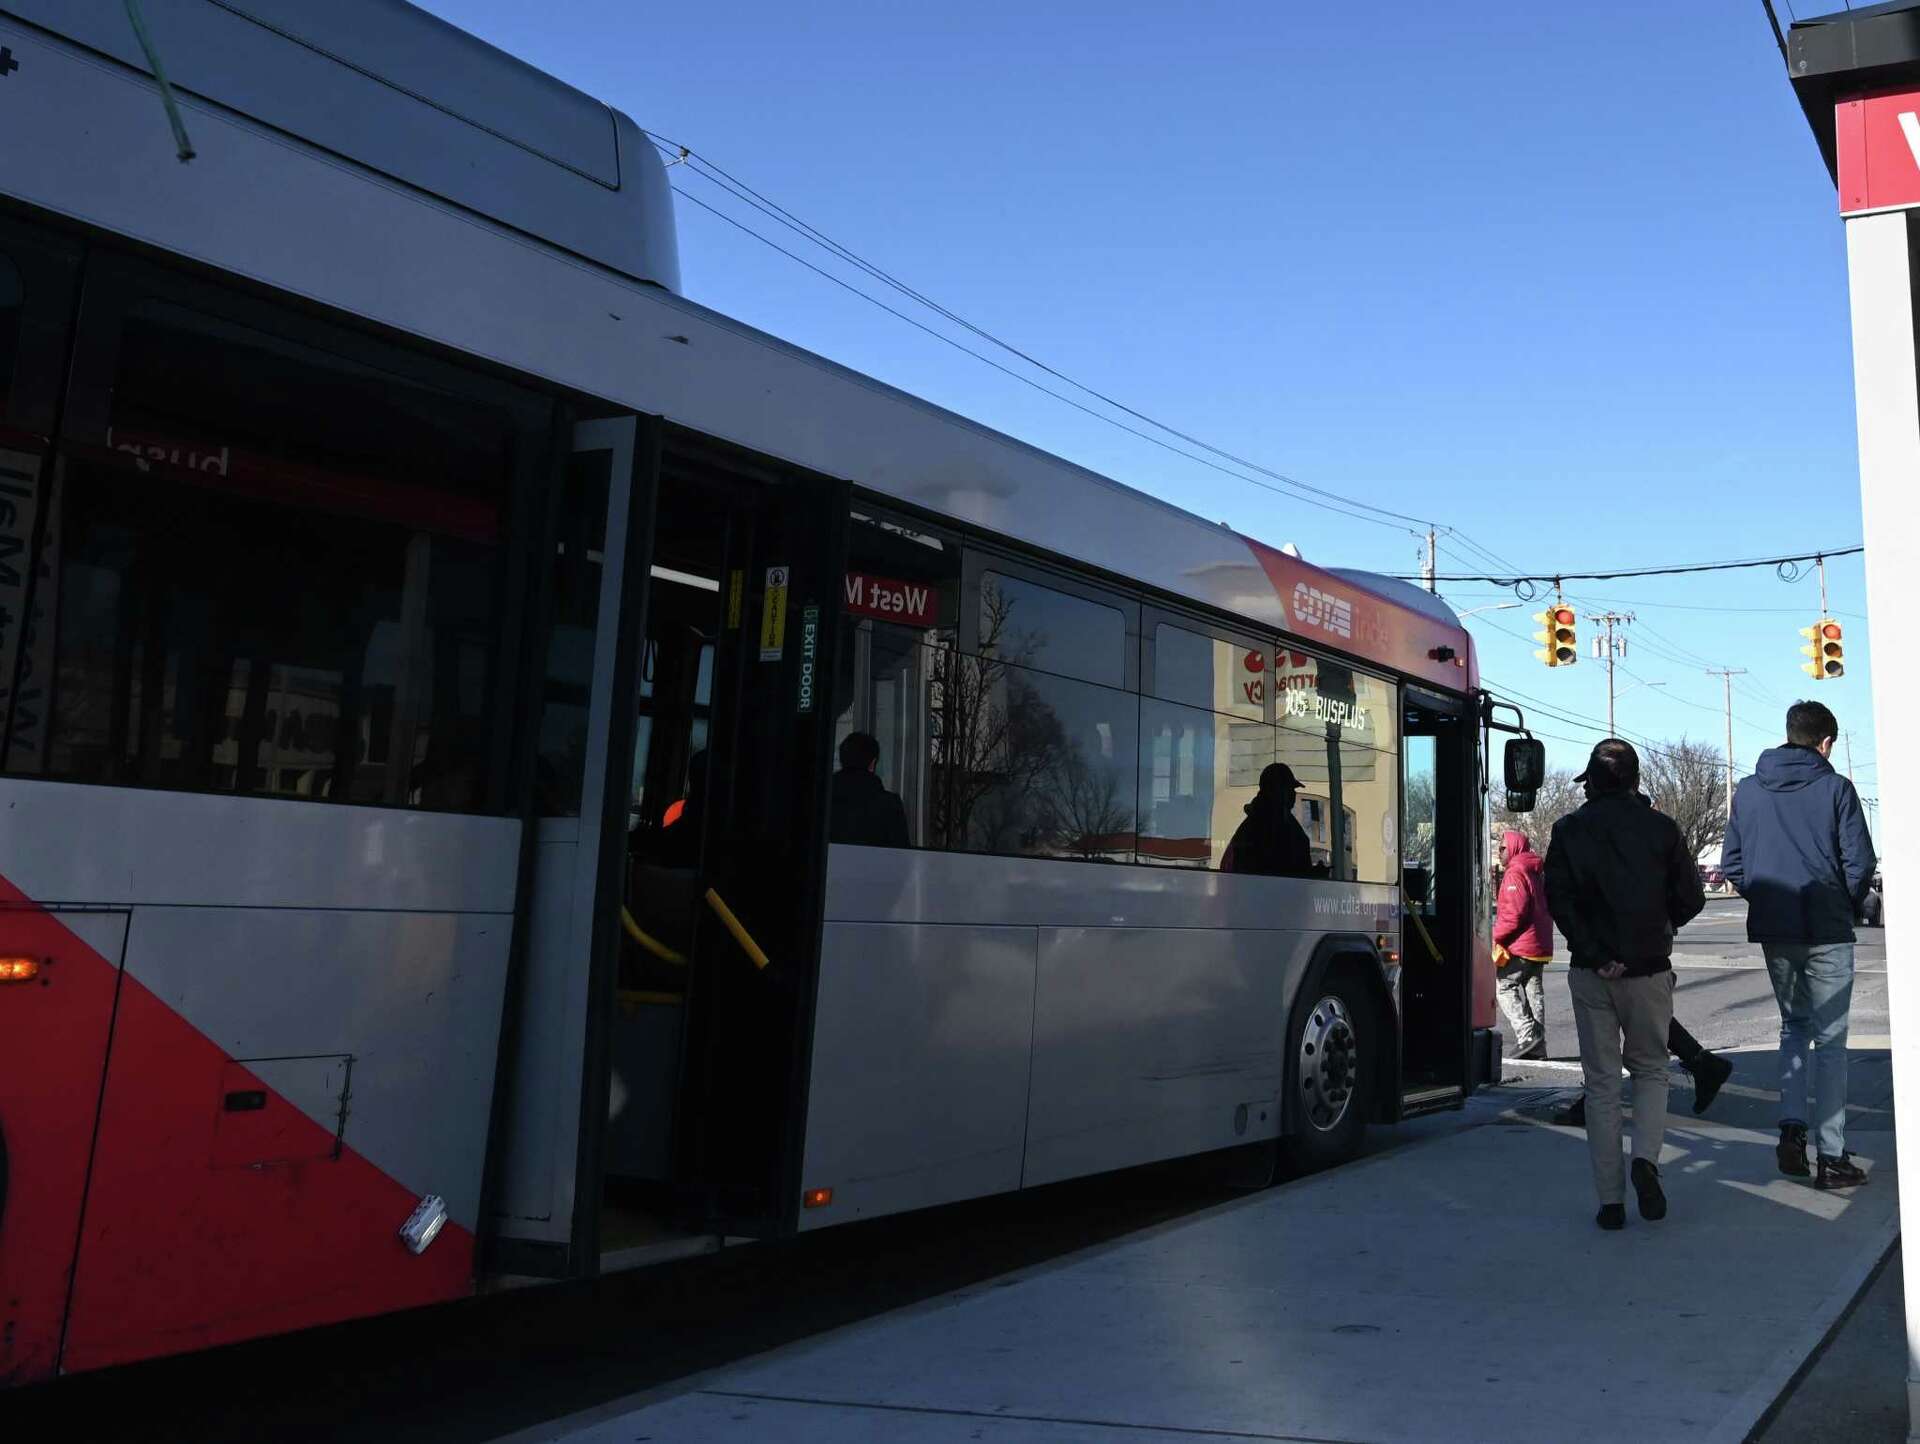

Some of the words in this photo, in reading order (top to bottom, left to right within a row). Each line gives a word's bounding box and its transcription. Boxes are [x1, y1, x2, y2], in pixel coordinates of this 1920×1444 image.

[1293, 582, 1351, 640] CDTA
[803, 623, 816, 659] EXIT
[799, 663, 813, 710] DOOR
[1315, 695, 1366, 730] BUSPLUS
